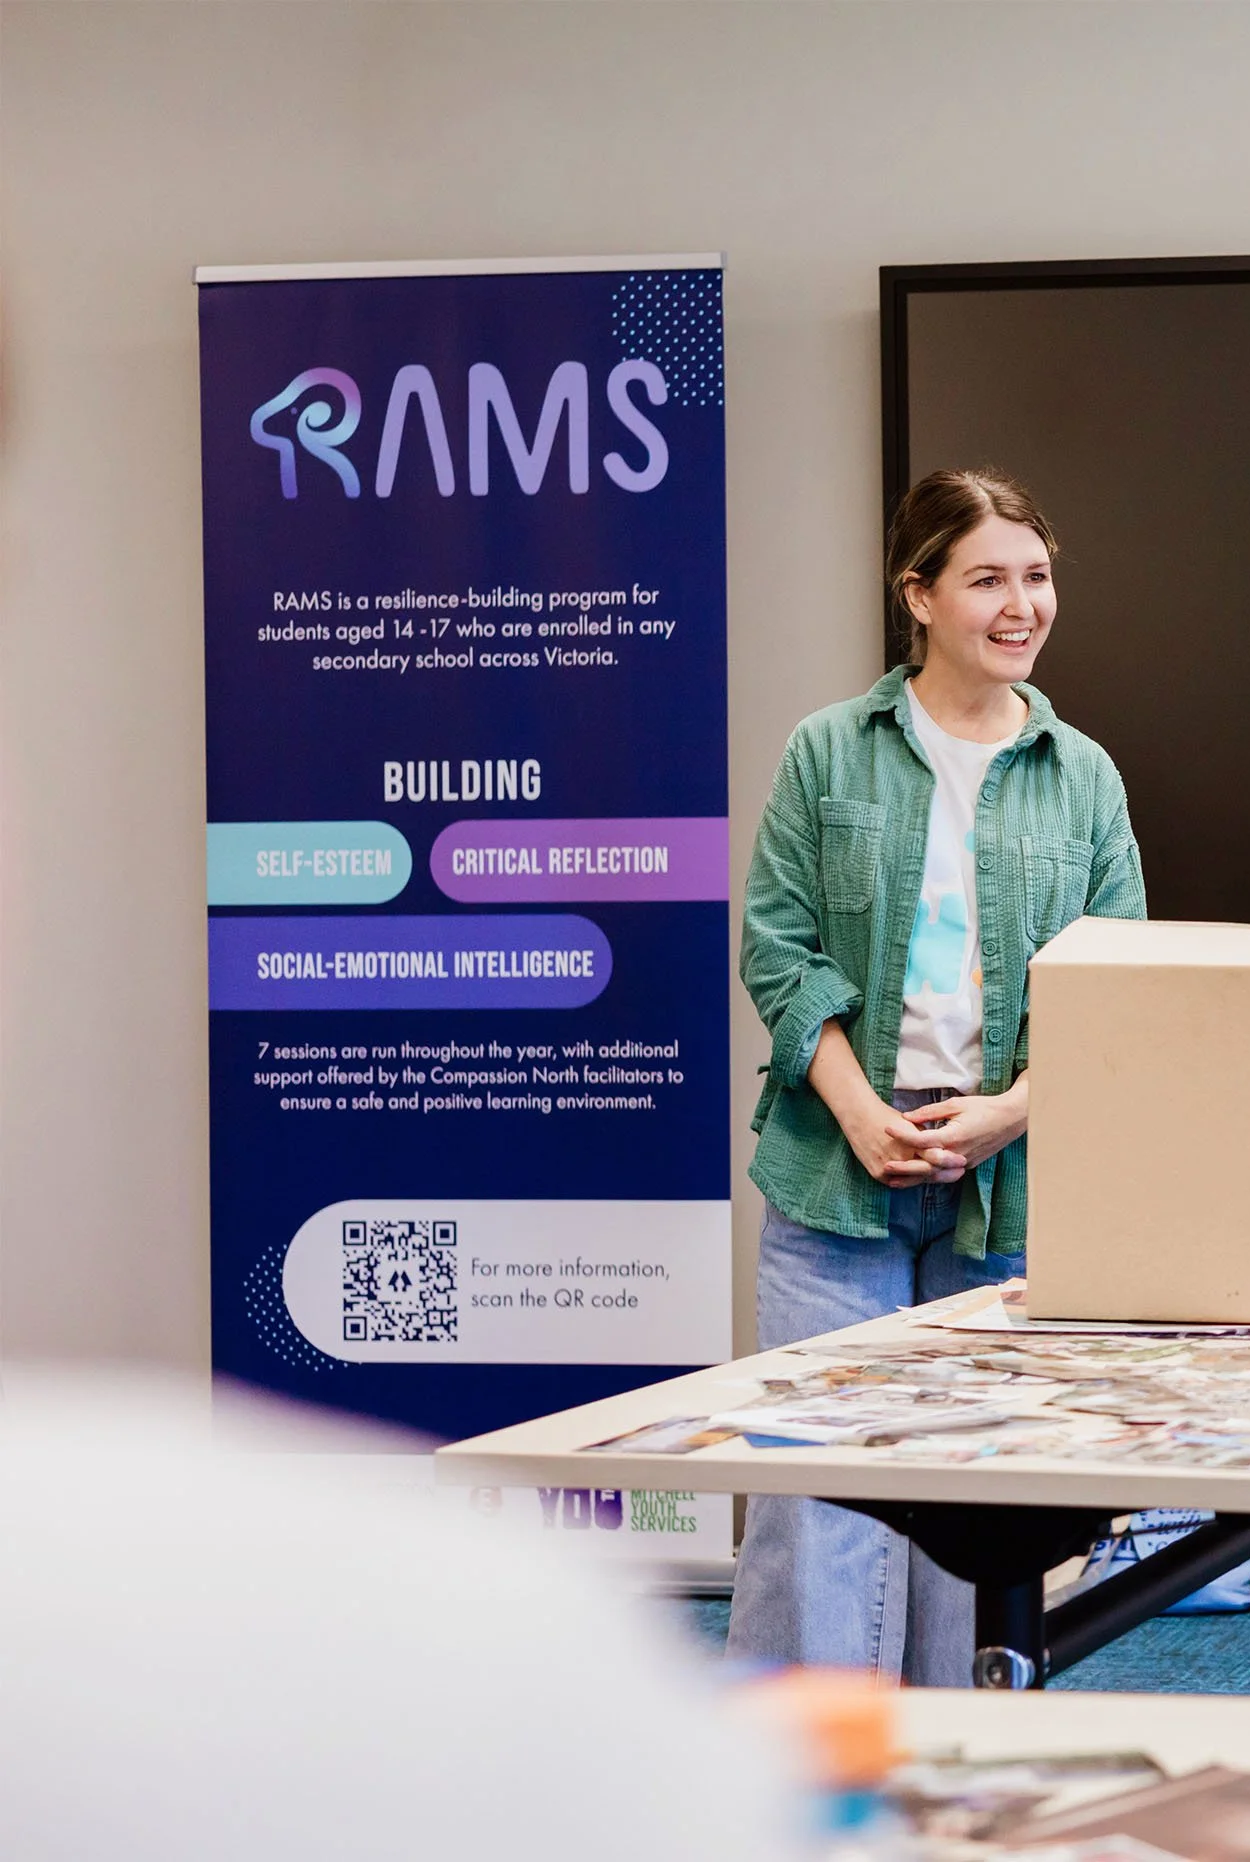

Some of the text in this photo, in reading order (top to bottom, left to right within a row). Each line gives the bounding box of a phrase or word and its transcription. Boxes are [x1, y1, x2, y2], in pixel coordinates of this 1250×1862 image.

[249, 359, 670, 500] RAMS
[273, 582, 660, 613] RAMS is a resilience-building program for
[257, 619, 331, 642] students
[335, 618, 385, 646] aged
[455, 616, 496, 638] who
[501, 622, 533, 638] are
[537, 613, 612, 637] enrolled
[617, 615, 634, 635] in
[639, 620, 676, 640] any
[312, 646, 619, 674] secondary school across Victoria.
[383, 758, 541, 802] BUILDING
[256, 849, 392, 878] SELF-ESTEEM
[452, 846, 668, 876] CRITICAL REFLECTION
[257, 950, 594, 980] SOCIAL-EMOTIONAL INTELLIGENCE
[258, 1039, 679, 1064] 7 sessions are run throughout the year, with additional
[253, 1064, 684, 1089] support offered by the Compassion North facilitators to
[279, 1090, 656, 1114] ensure a safe and positive learning environment.
[471, 1255, 670, 1281] For more information,
[471, 1287, 639, 1308] scan the QR code
[631, 1500, 677, 1517] YOUTH
[631, 1515, 697, 1532] SERVICES
